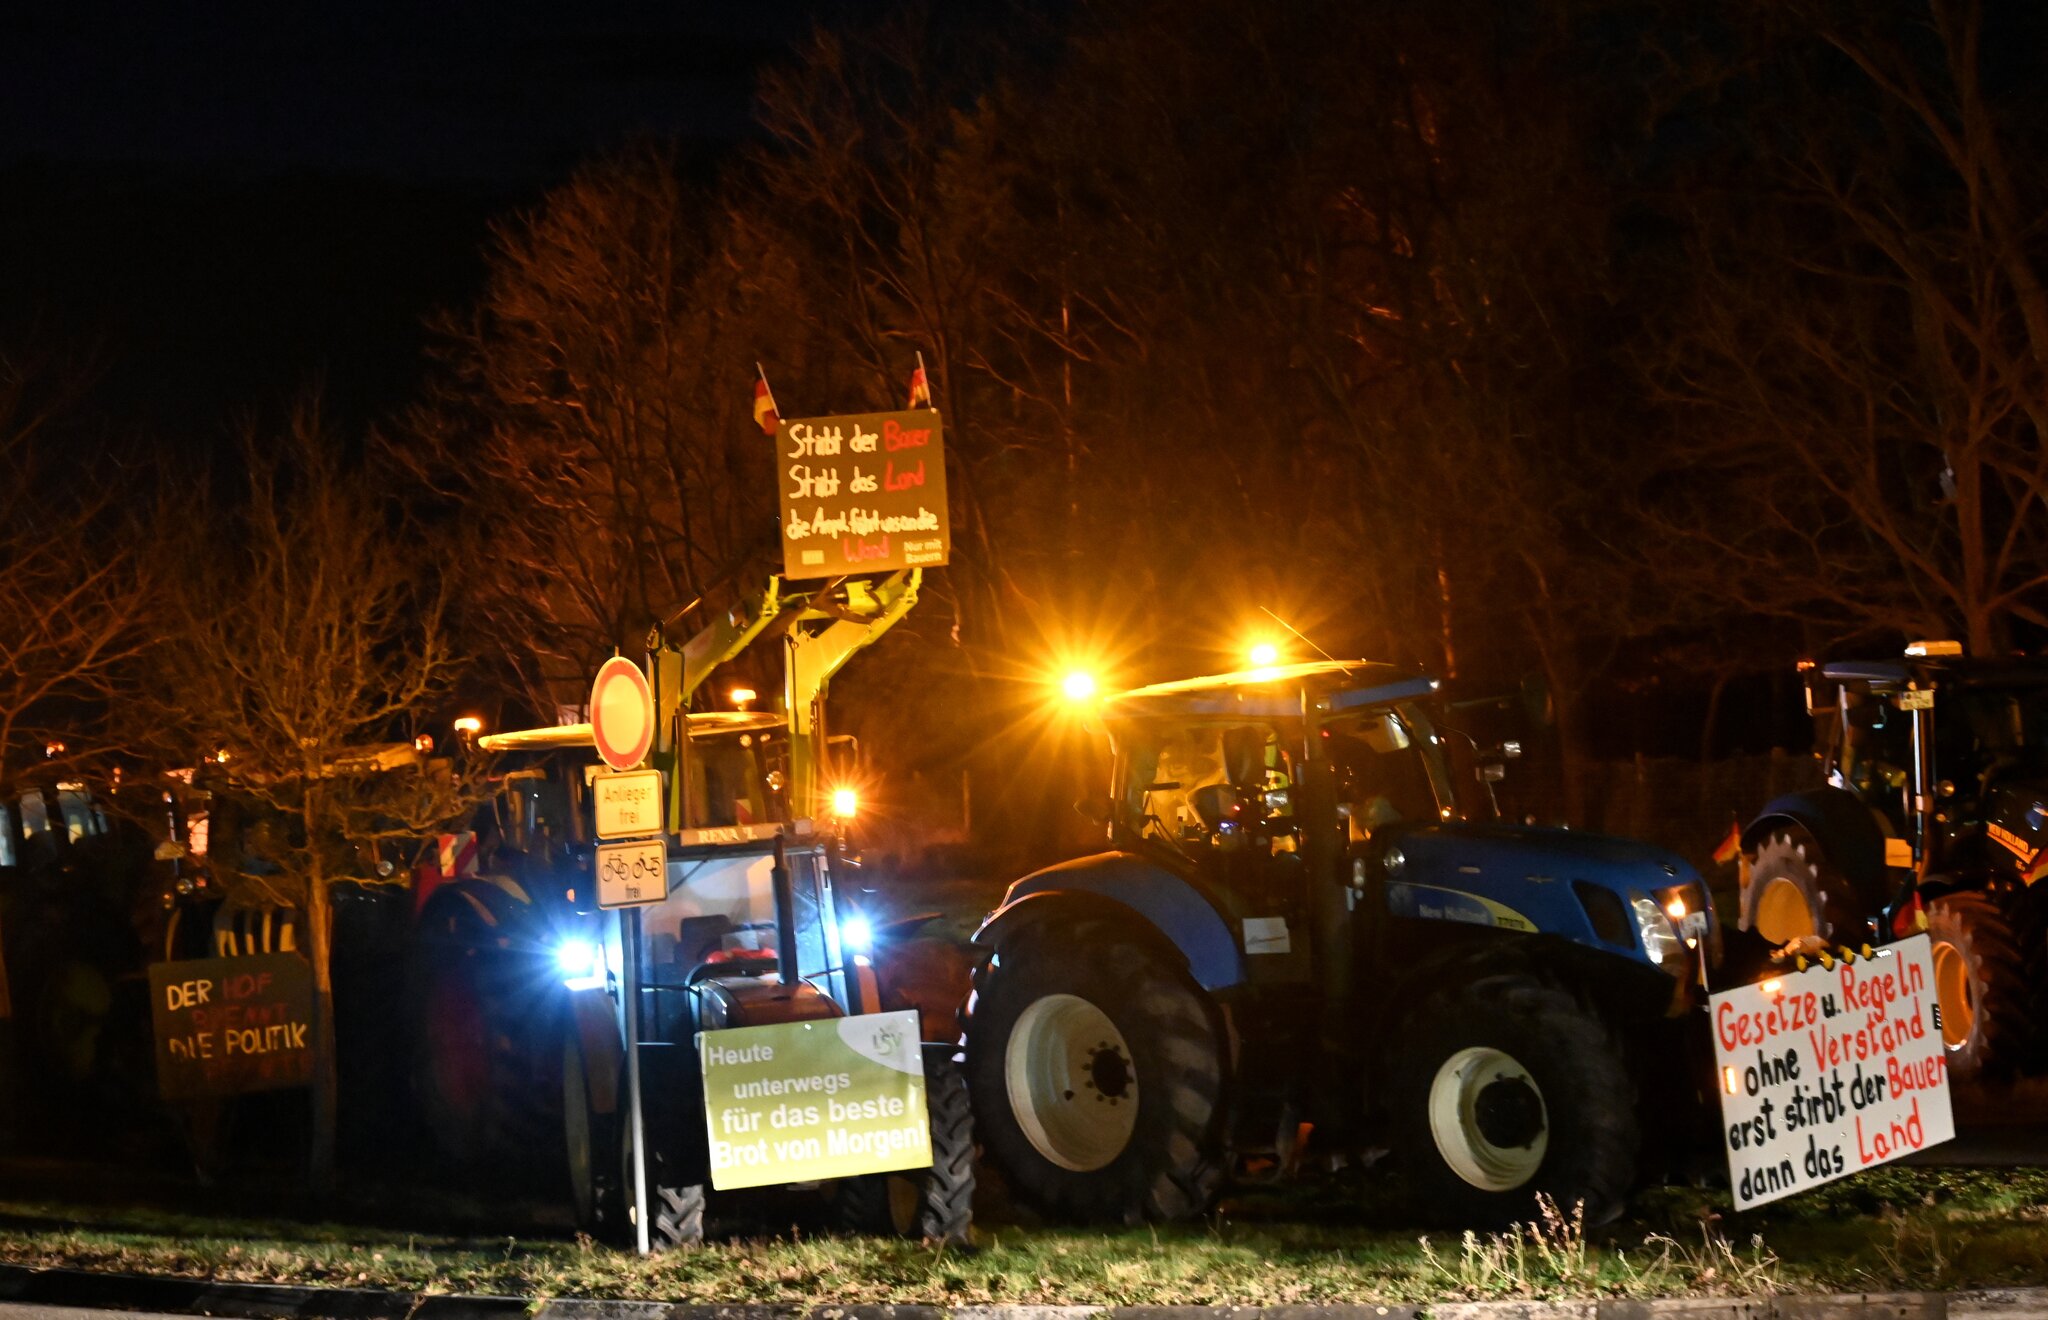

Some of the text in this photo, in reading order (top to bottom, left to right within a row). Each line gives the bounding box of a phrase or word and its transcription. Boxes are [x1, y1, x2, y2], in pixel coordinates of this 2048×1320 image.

[849, 424, 879, 453] der
[850, 465, 878, 494] das
[884, 459, 925, 492] Land
[604, 786, 652, 805] Anlieger
[619, 808, 640, 825] frei
[166, 971, 273, 1011] DER HOF
[1717, 950, 1925, 1051] Gesetze u. Regeln
[169, 1021, 308, 1061] DIE POLITIK
[708, 1045, 774, 1066] Heute
[1744, 996, 1925, 1097] ohne Verstand
[734, 1072, 851, 1099] unterwegs
[1729, 1054, 1947, 1151] erst stirbt der Bauer
[721, 1094, 904, 1134] für das beste
[715, 1120, 928, 1168] Brot von Morgen!
[1739, 1097, 1925, 1201] dann das Land
